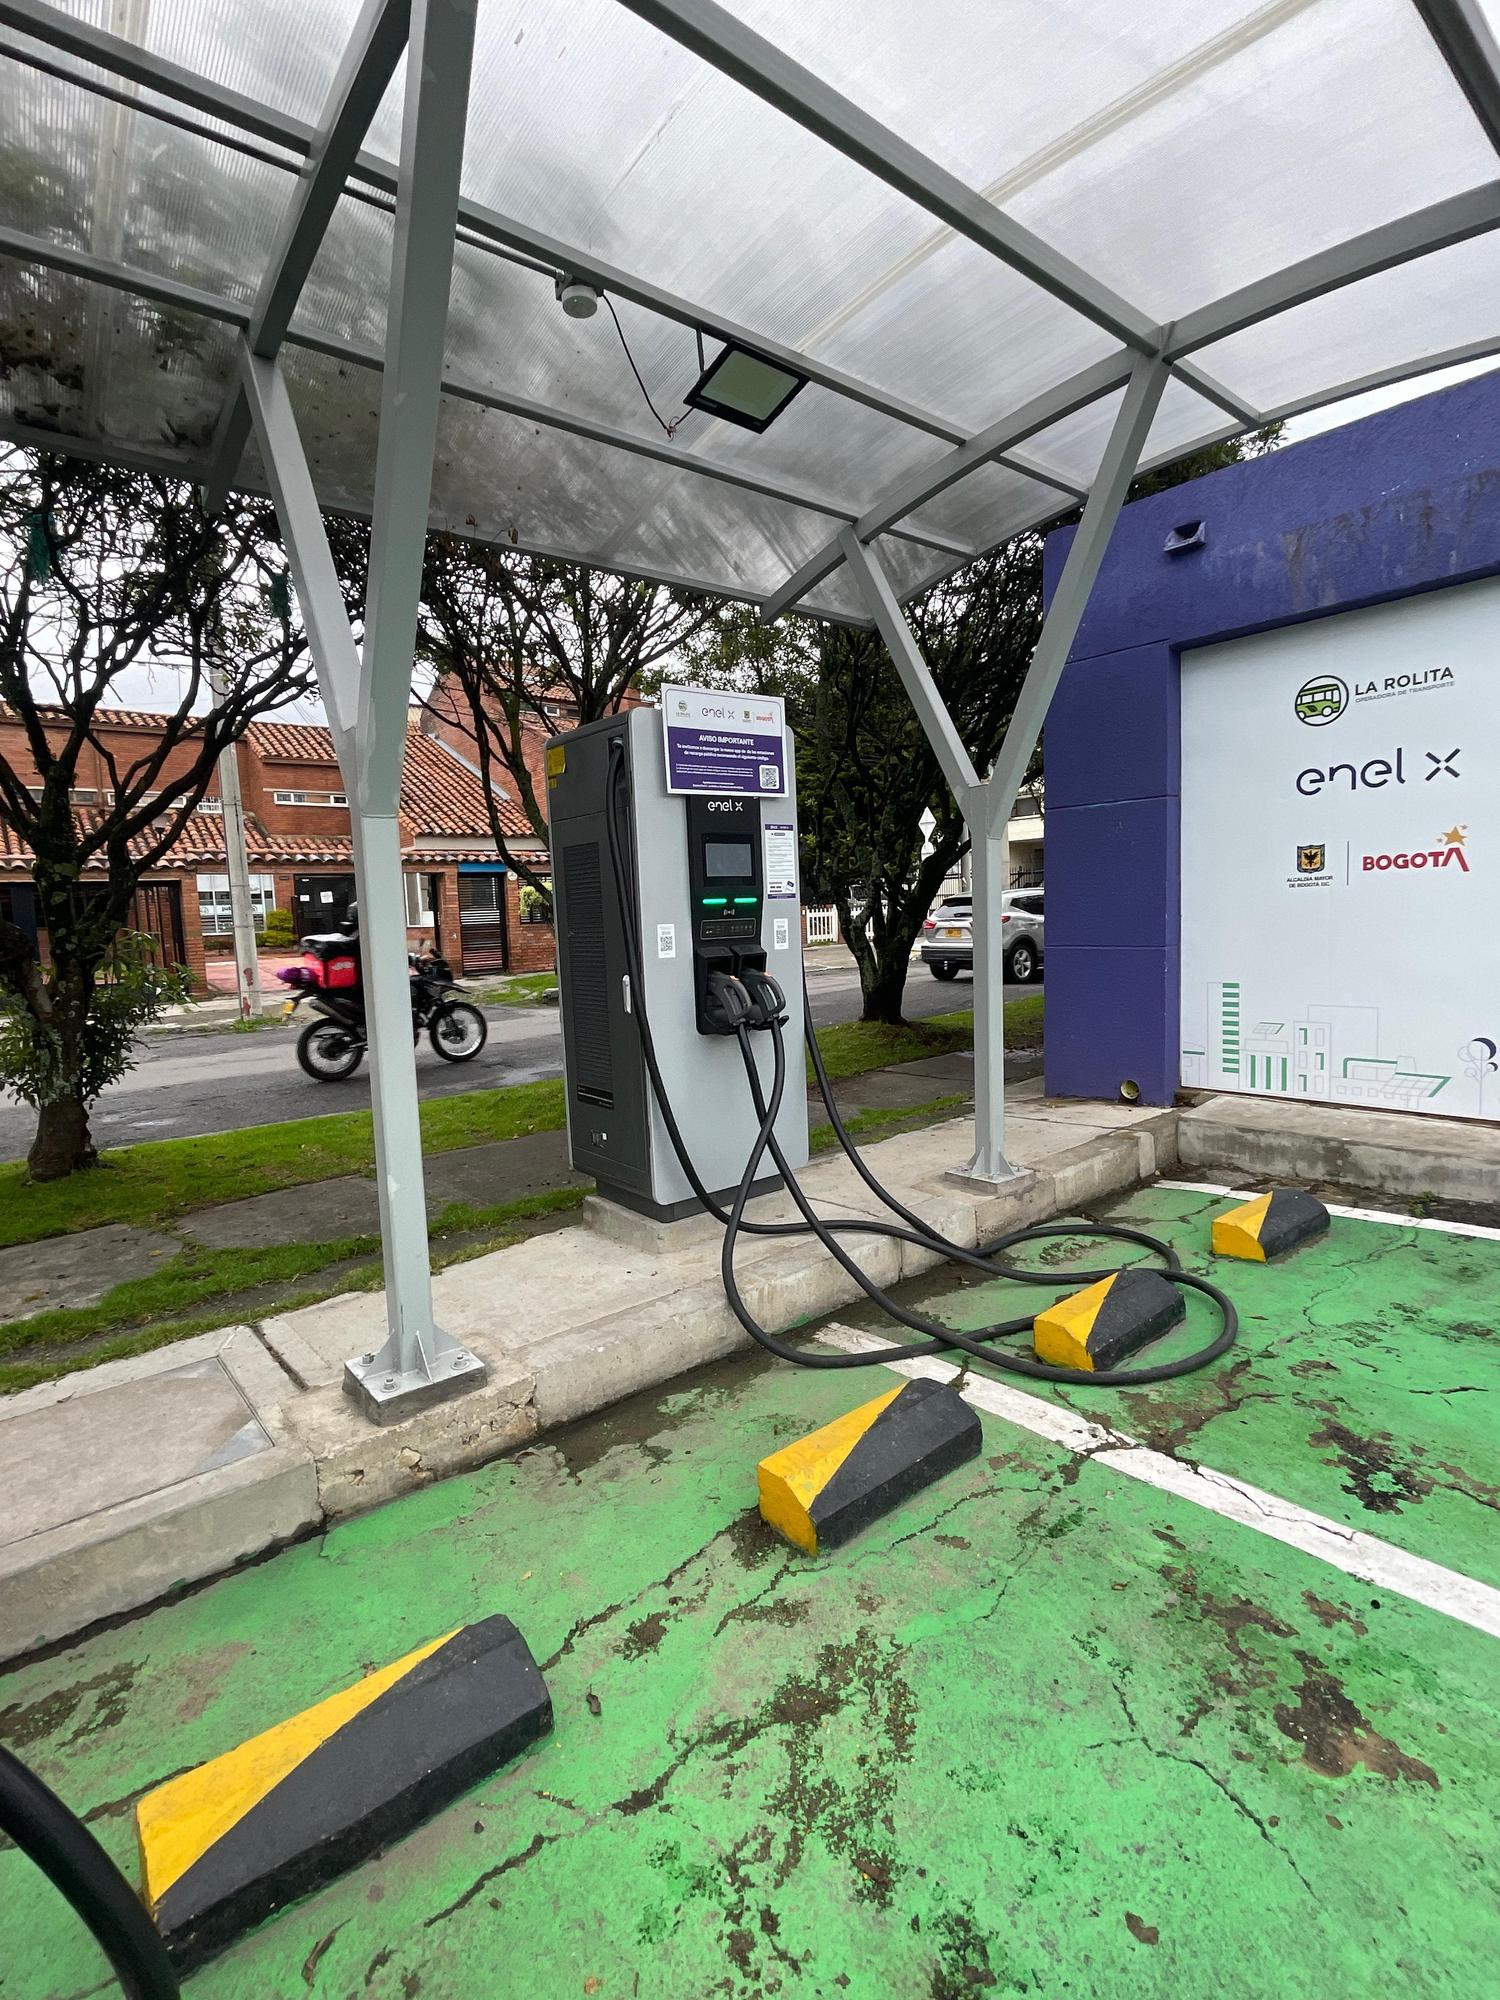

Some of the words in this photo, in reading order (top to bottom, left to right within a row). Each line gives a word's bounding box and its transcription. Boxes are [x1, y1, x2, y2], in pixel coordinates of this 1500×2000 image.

[1355, 681, 1377, 695] LA
[1384, 667, 1454, 690] ROLITA
[1355, 692, 1396, 703] OPERADORA
[1409, 681, 1455, 694] TRANSPORTE
[701, 707, 725, 719] enel
[699, 734, 717, 743] AVISO
[718, 736, 754, 746] IMPORTANTE
[1296, 747, 1406, 796] enel
[707, 799, 733, 812] enel
